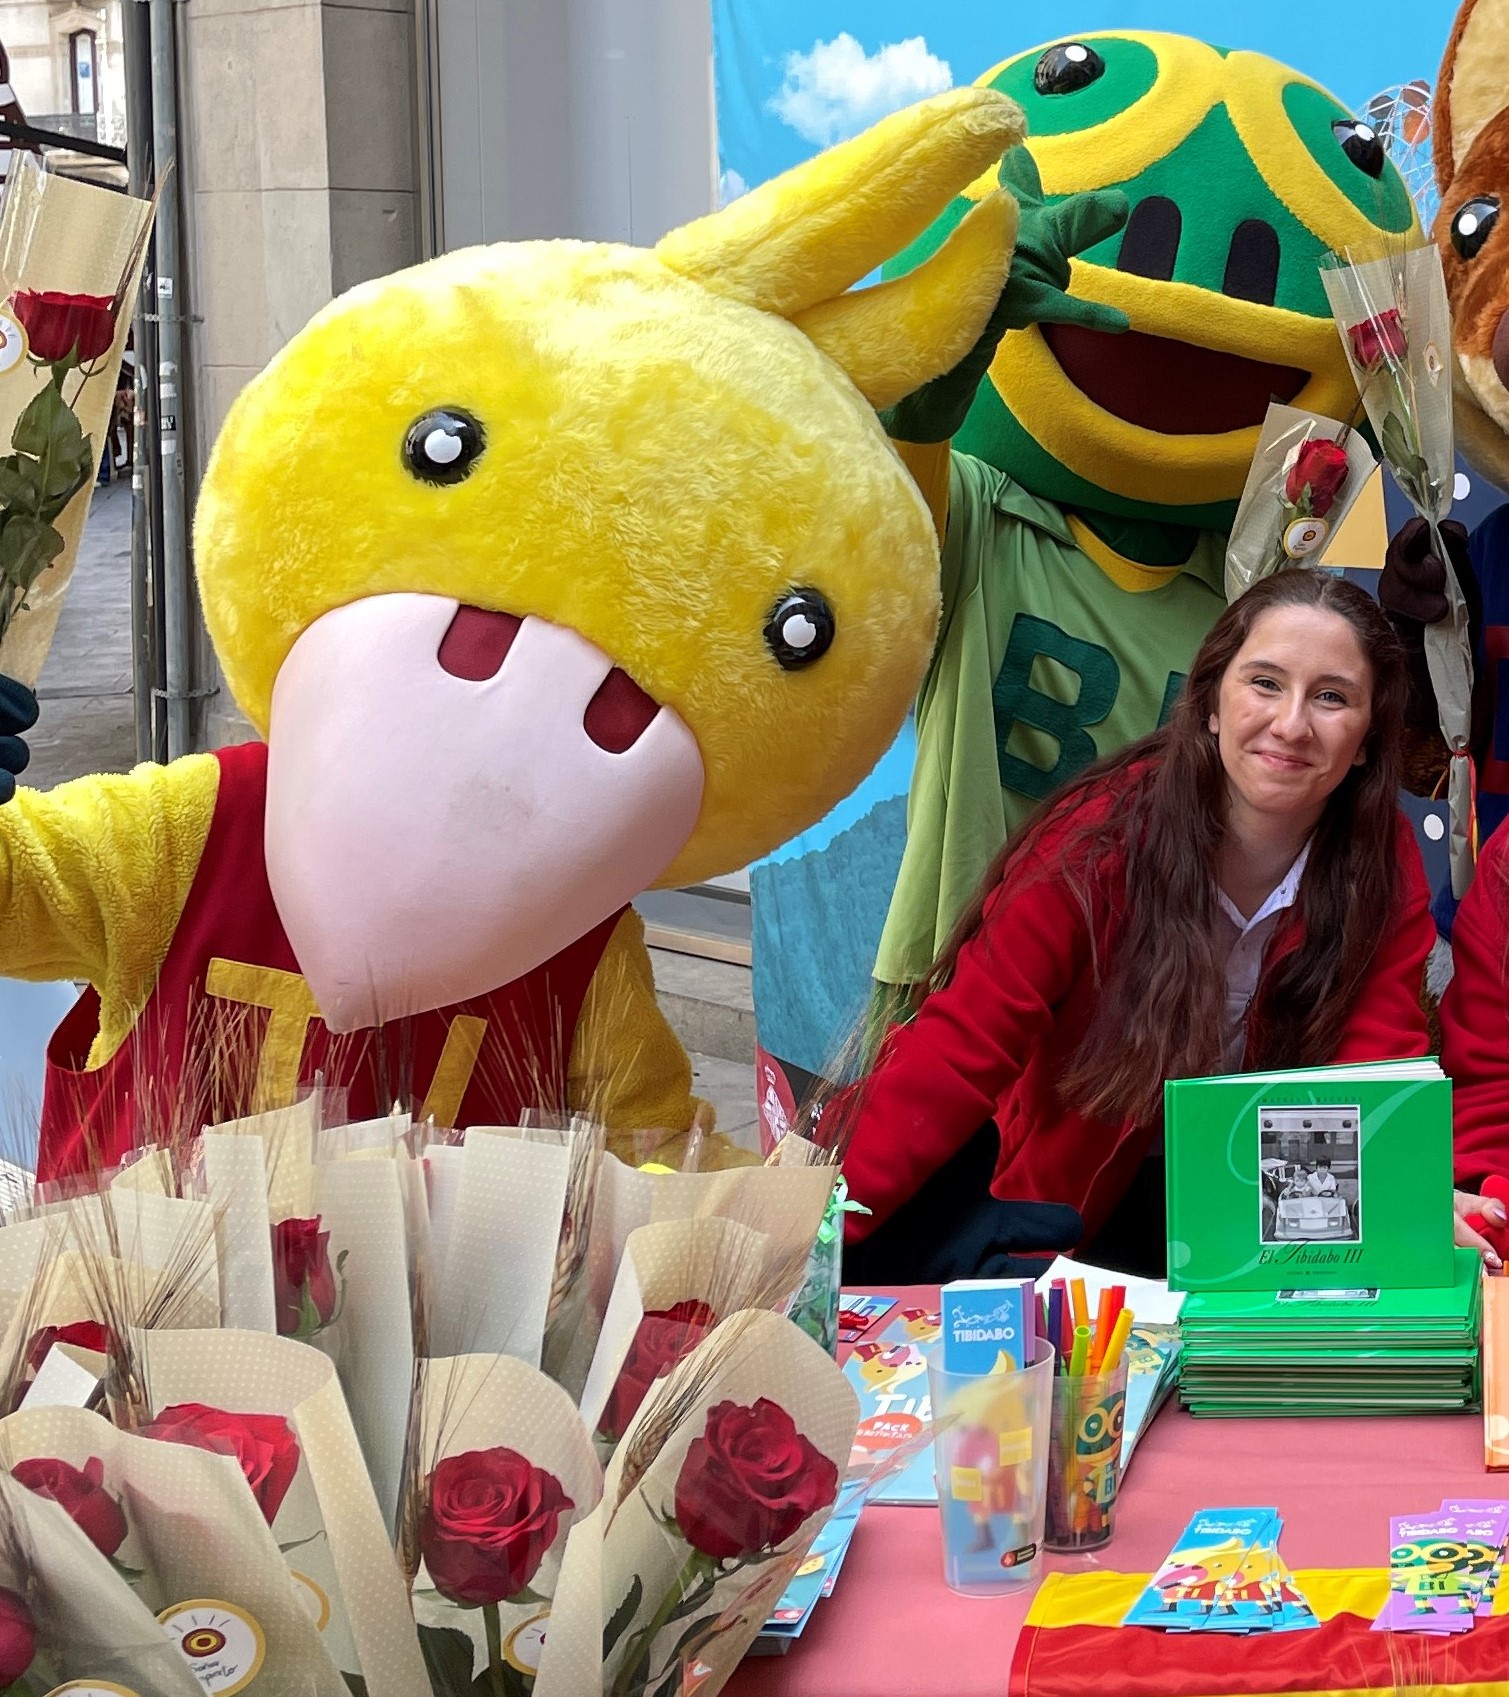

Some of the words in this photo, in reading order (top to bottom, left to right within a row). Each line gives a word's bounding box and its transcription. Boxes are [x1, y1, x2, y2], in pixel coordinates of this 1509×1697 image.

[1259, 1249, 1275, 1264] El
[1274, 1237, 1341, 1264] Tibidabo
[1343, 1249, 1364, 1264] III
[953, 1327, 1015, 1342] TIBIDABO
[873, 1421, 910, 1431] PACK
